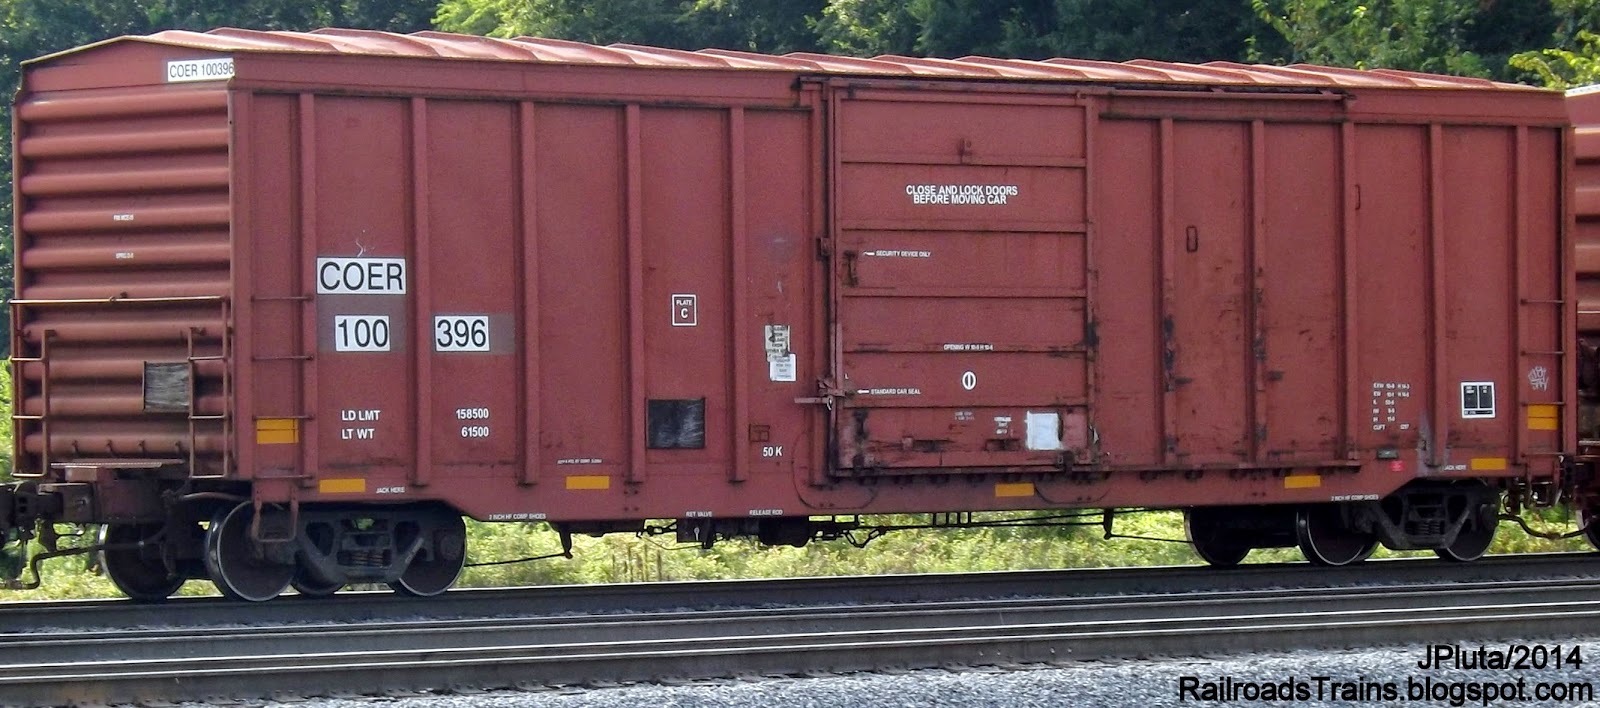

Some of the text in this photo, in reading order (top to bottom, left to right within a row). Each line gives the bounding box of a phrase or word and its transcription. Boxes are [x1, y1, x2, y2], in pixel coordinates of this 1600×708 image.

[169, 62, 235, 78] COER 100396
[906, 184, 1018, 196] CLOSE AND LOCK DOORS
[913, 194, 1007, 205] BEFORE MOVING CAR
[900, 250, 919, 258] DEVICE
[319, 261, 403, 291] COER
[676, 299, 693, 307] PLATE
[680, 308, 689, 319] C
[337, 318, 487, 348] 100 396
[341, 408, 489, 421] LD LMT 158500
[341, 426, 489, 439] LT WT 61500
[762, 446, 783, 457] 50 K
